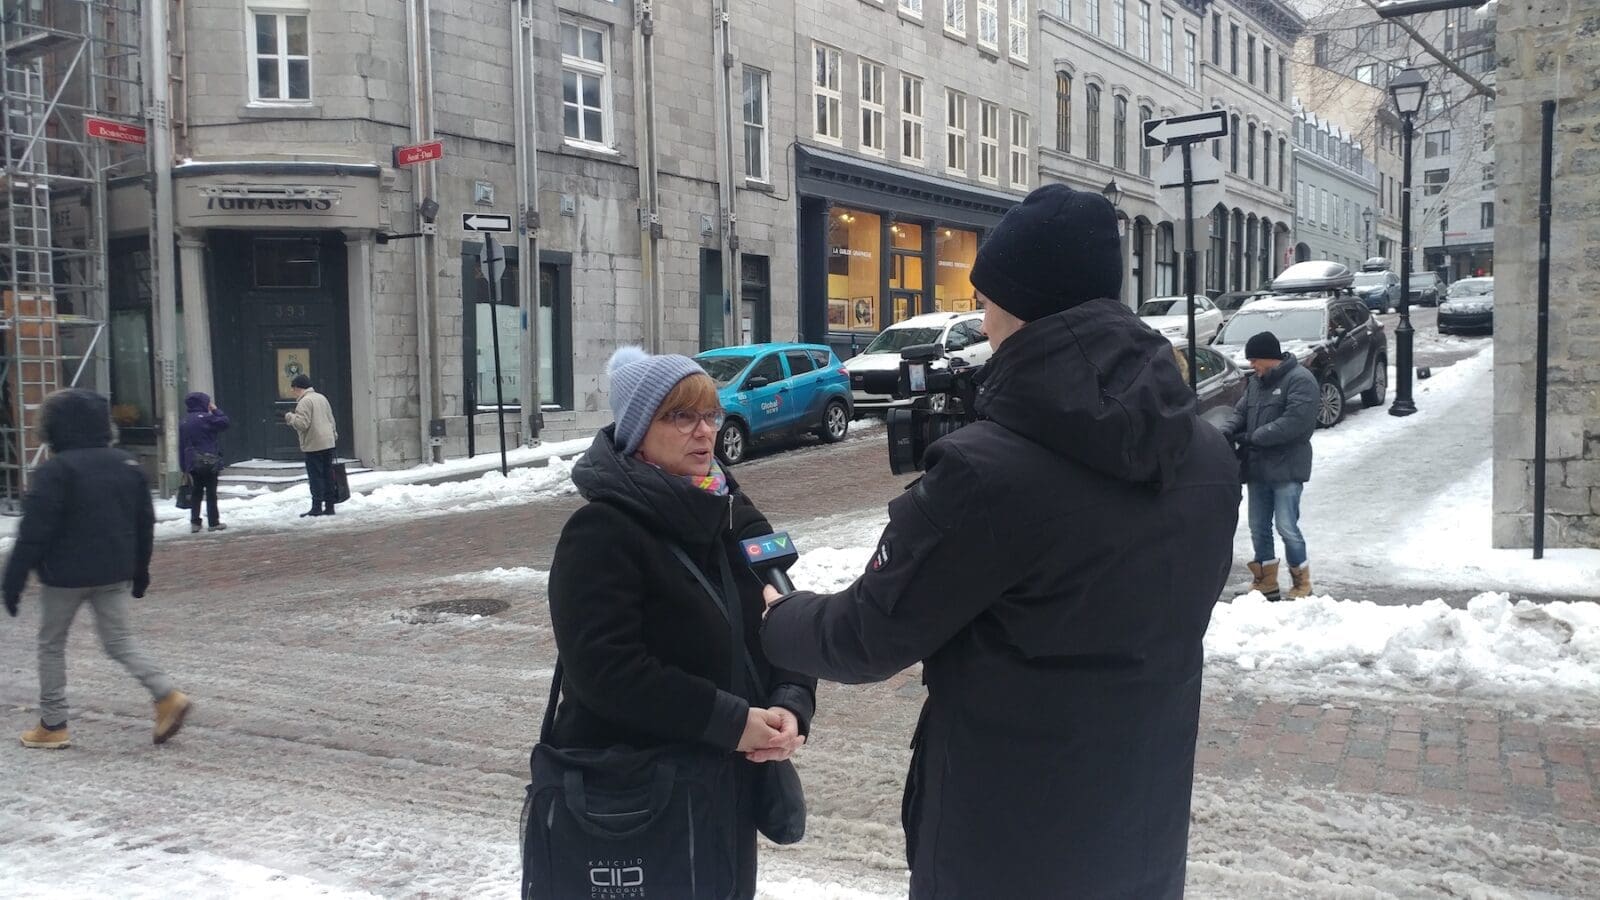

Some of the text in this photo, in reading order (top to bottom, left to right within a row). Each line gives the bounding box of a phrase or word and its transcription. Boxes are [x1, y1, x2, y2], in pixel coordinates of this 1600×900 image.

[760, 399, 778, 411] Global
[747, 536, 788, 555] CTV
[588, 857, 643, 867] KAICIID
[591, 886, 644, 894] DIALOGUE
[591, 892, 645, 900] CENTRE
